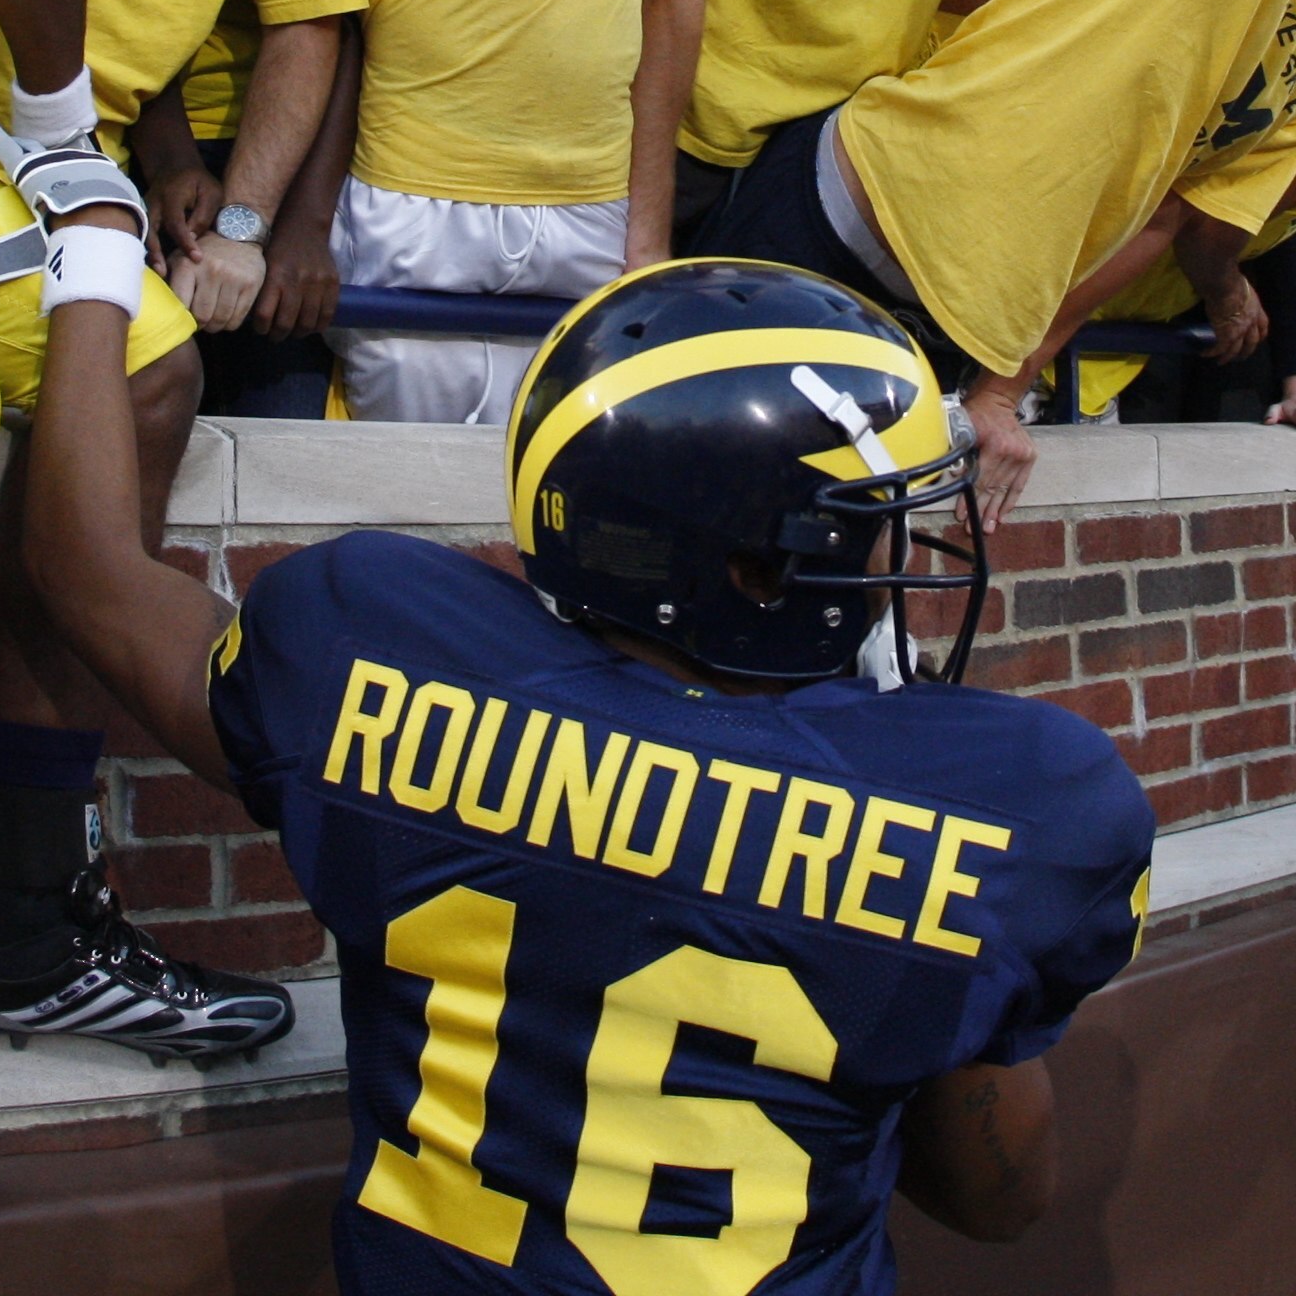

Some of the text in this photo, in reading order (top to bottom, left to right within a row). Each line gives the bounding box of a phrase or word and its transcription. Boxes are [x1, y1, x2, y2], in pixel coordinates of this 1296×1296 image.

[540, 488, 565, 532] 16
[322, 658, 1012, 959] ROUNDTREE
[356, 884, 839, 1296] 16
